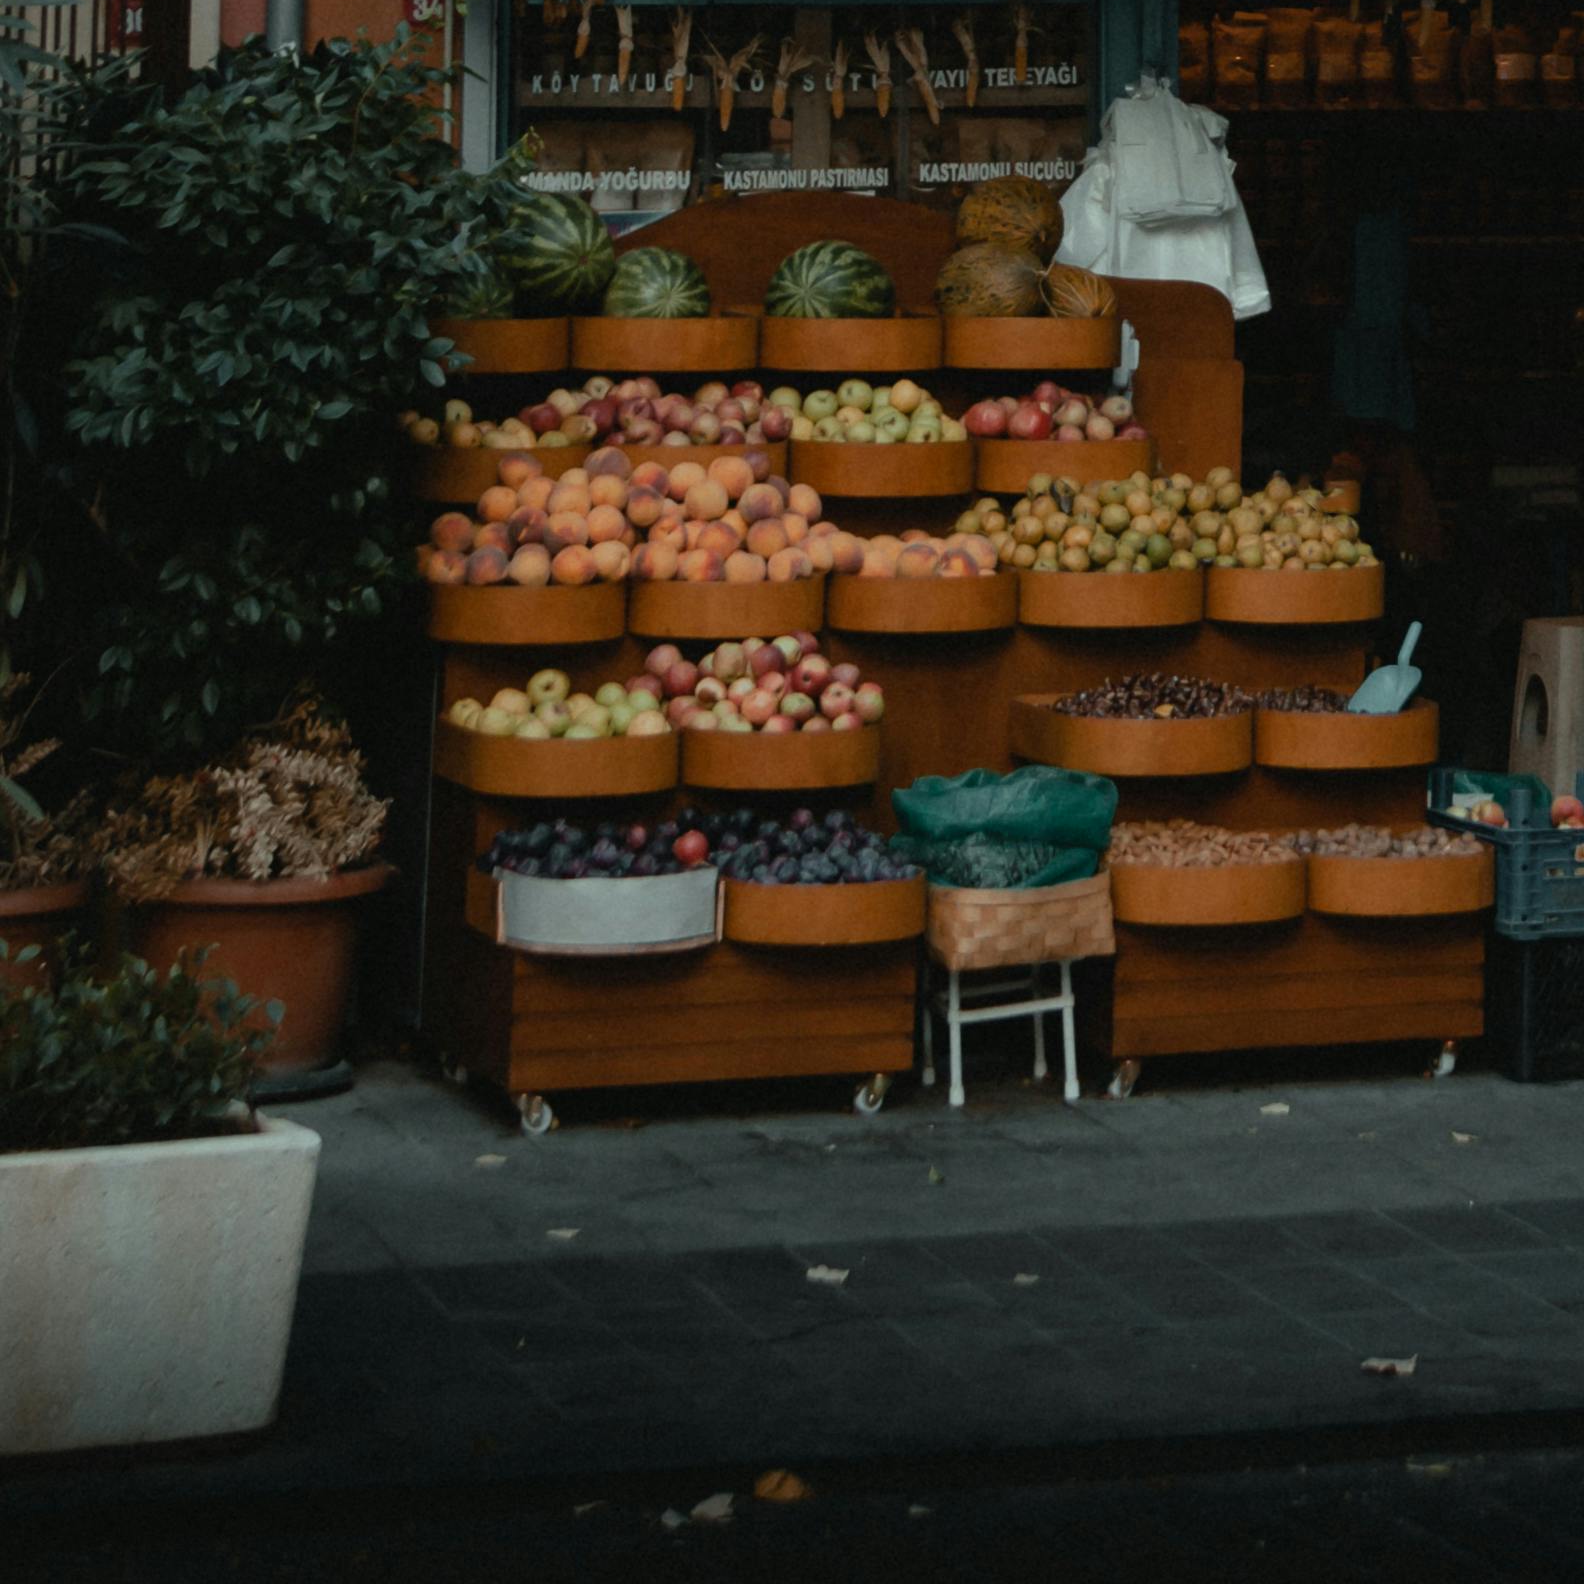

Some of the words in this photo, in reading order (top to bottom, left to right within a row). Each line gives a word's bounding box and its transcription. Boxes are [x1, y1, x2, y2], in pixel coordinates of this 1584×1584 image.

[532, 71, 580, 93] KÖY
[599, 166, 692, 191] YOĞURDU
[724, 170, 807, 190] KASTAMONU
[811, 167, 889, 188] PASTIRMASI
[920, 162, 1012, 182] KASTAMONU
[1015, 157, 1076, 180] SUCUĞU
